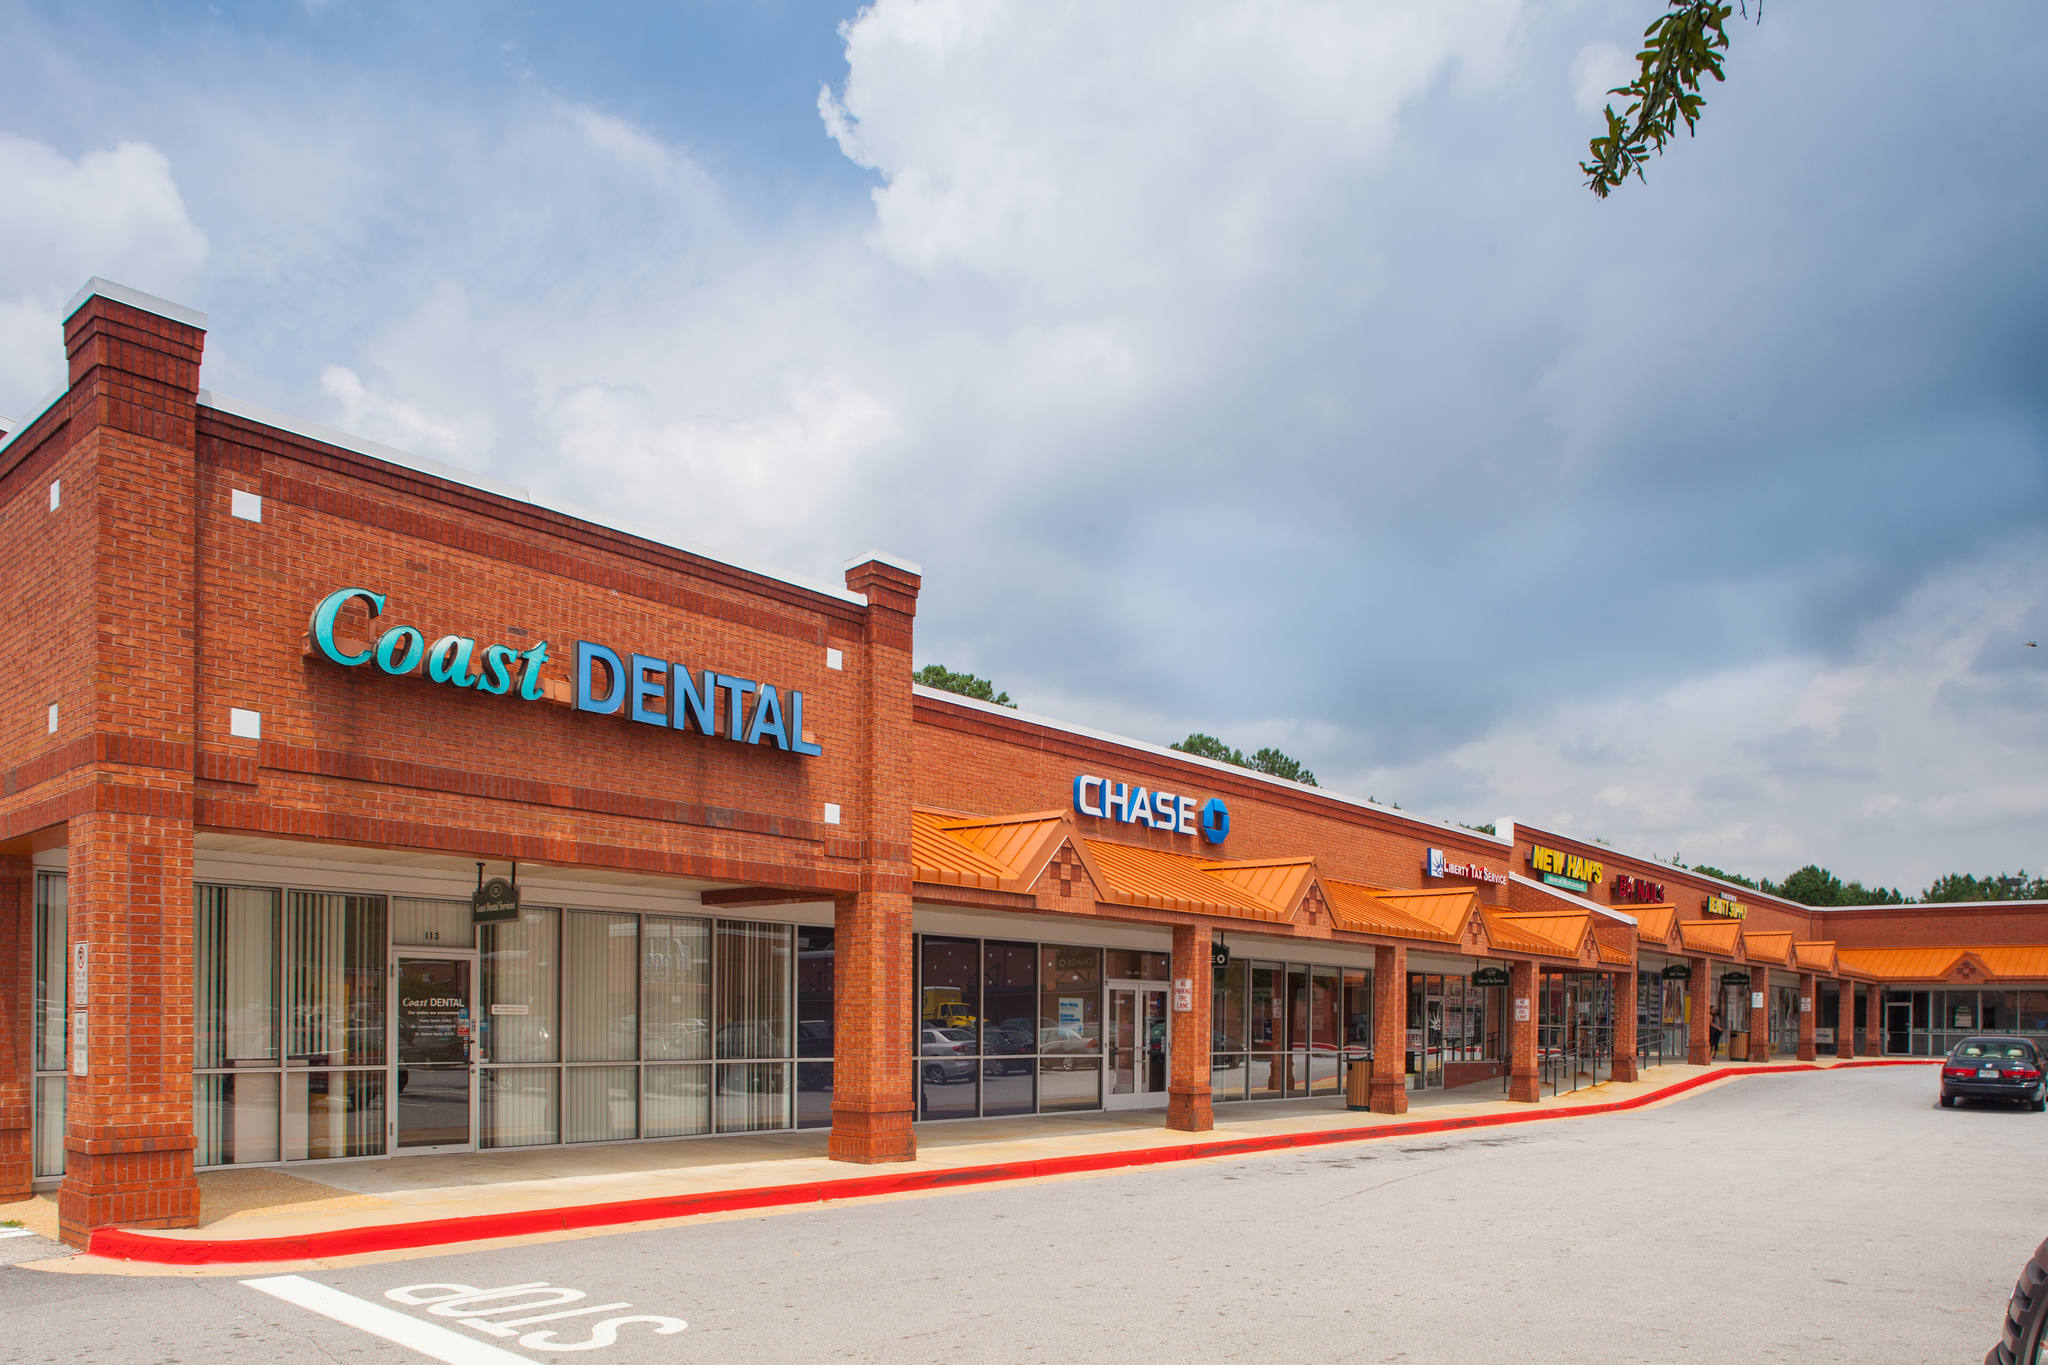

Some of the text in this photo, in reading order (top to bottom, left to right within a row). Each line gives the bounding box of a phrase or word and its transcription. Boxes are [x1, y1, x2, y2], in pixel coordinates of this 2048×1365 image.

[308, 587, 822, 757] Coast DENTAL
[1073, 775, 1198, 836] CHASE
[1532, 845, 1566, 875] NEW
[1566, 853, 1603, 884] HAN'S
[1635, 878, 1665, 904] NAILS
[1729, 901, 1747, 920] SUPPLY
[425, 931, 439, 940] 113
[402, 997, 465, 1007] Coast DENTAL
[384, 1281, 689, 1352] STOP
